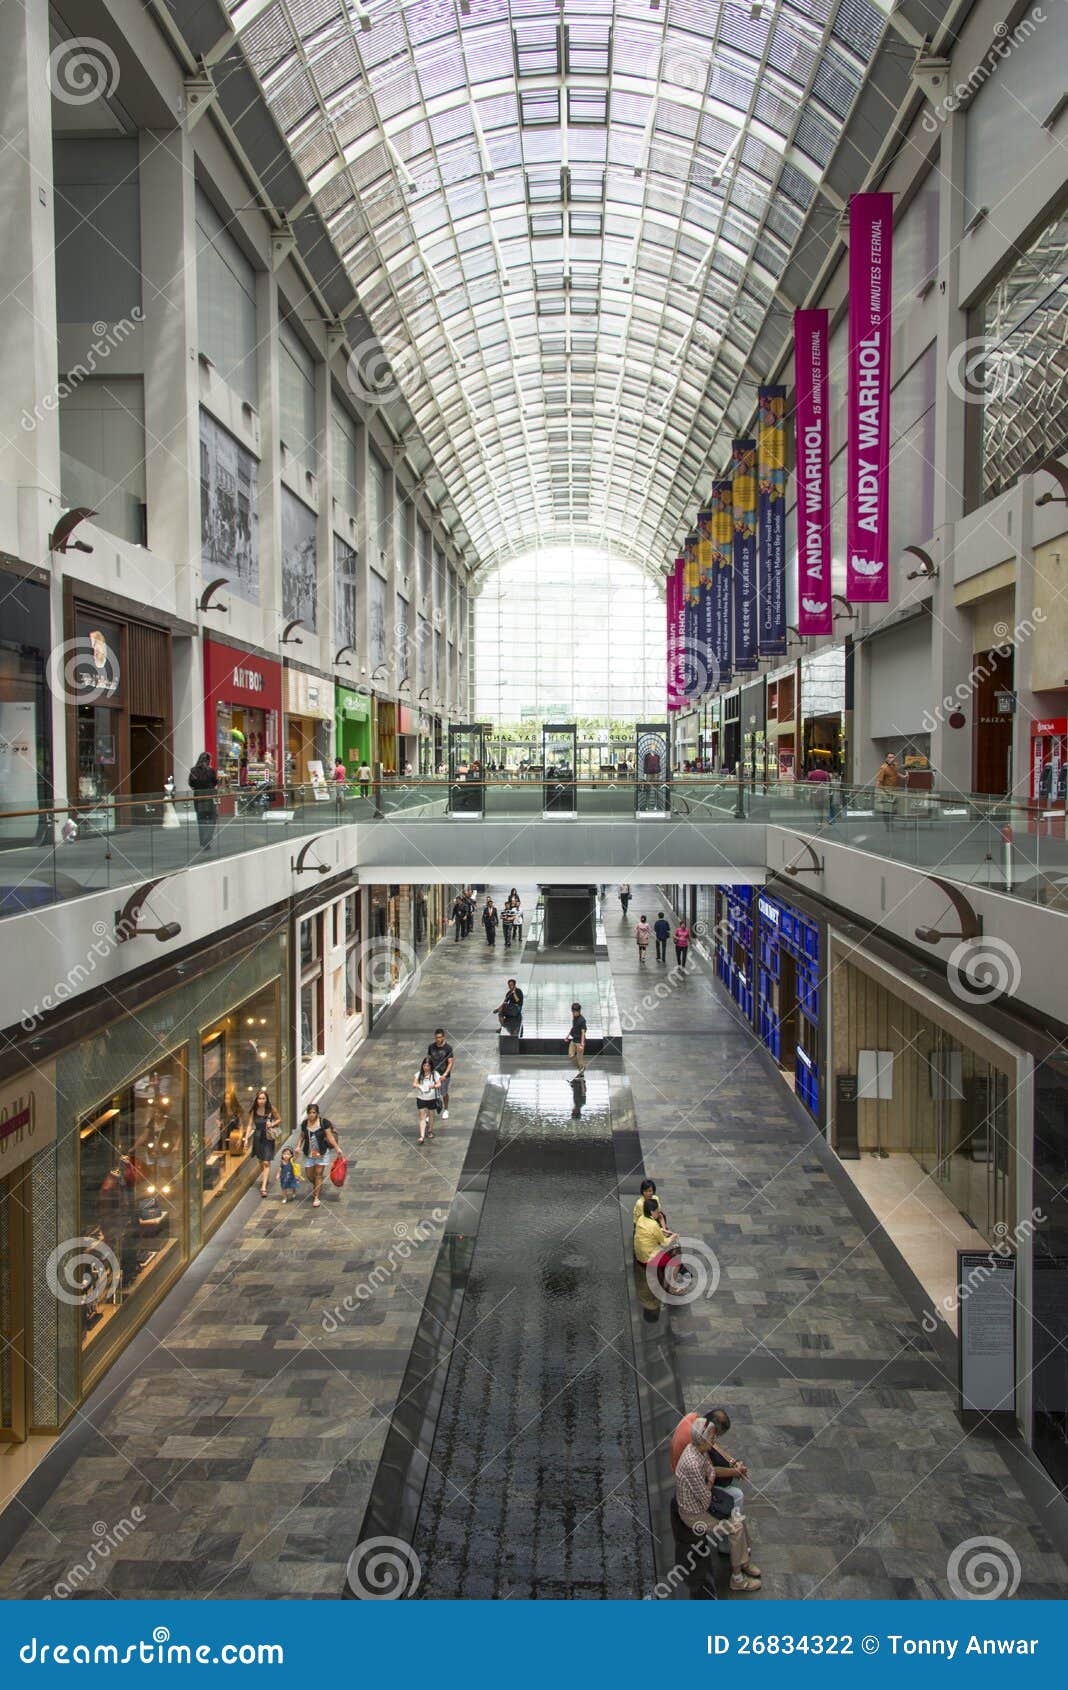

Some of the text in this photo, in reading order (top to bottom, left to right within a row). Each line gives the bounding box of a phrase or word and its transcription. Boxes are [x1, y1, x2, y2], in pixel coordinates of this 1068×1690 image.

[805, 329, 823, 580] ANDY WARHOL 15 MINUTES ETERNAL
[858, 219, 882, 534] ANDY WARHOL 15 MINUTES ETERNAL
